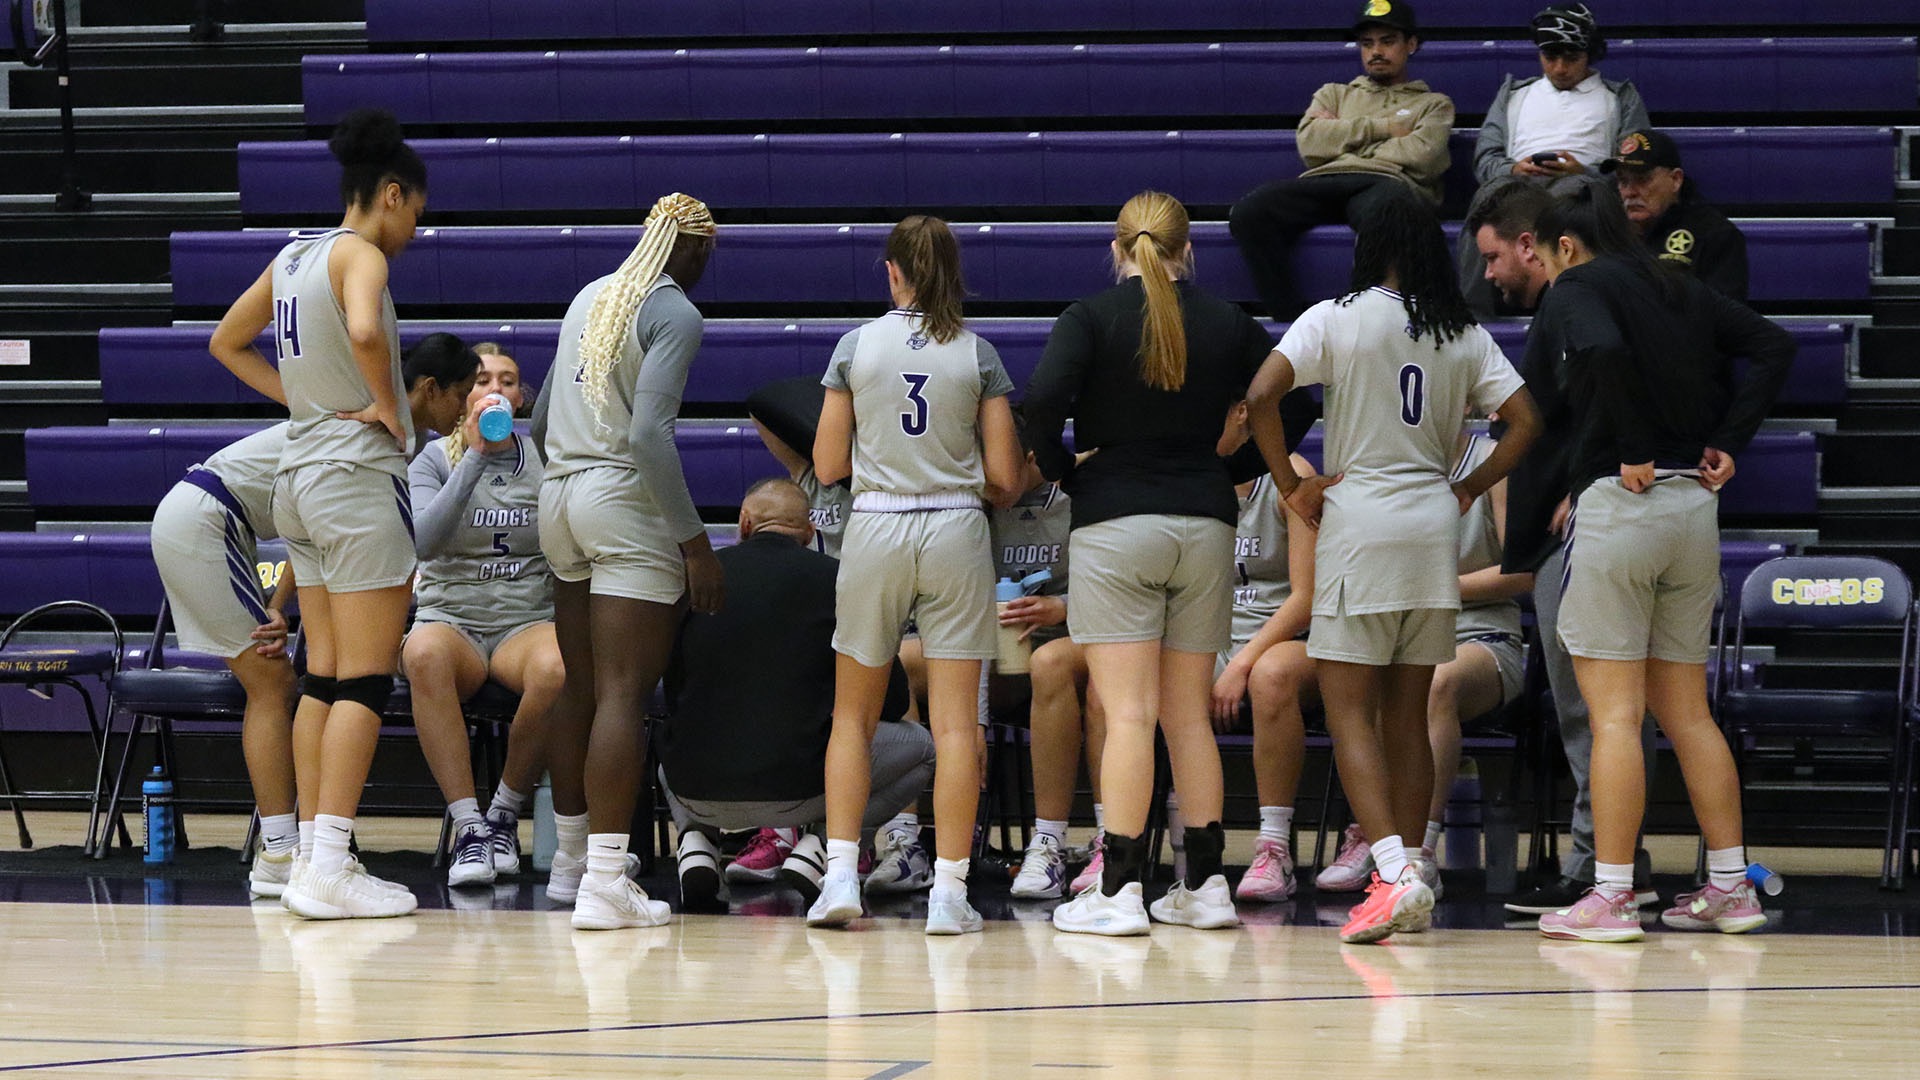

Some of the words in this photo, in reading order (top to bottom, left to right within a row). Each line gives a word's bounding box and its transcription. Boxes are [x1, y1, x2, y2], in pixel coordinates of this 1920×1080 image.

[276, 295, 302, 360] 14
[899, 371, 932, 437] 3
[1399, 363, 1425, 427] 0
[472, 507, 530, 528] DODGE
[809, 503, 841, 527] ODGE
[491, 531, 511, 558] 5
[1002, 544, 1061, 564] DODGE
[1234, 536, 1261, 557] DGE
[478, 562, 520, 581] CITY
[1234, 589, 1257, 605] TY
